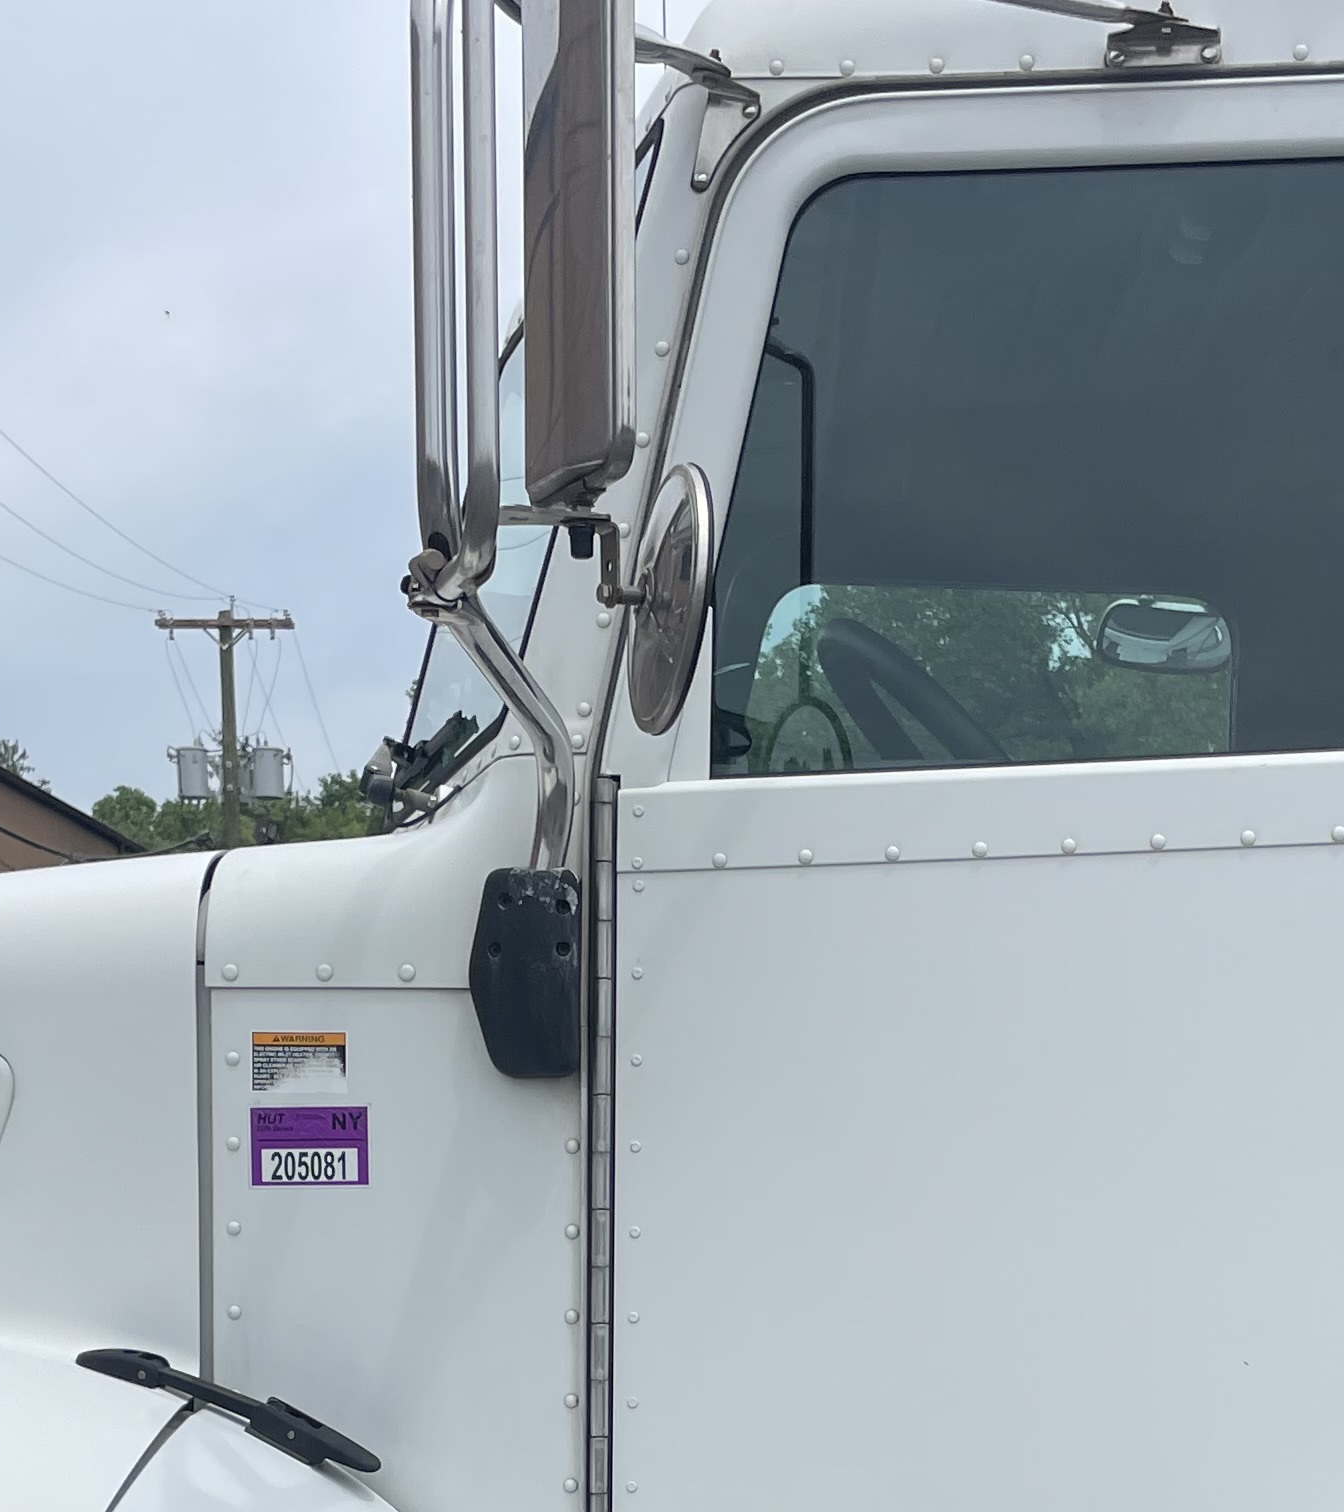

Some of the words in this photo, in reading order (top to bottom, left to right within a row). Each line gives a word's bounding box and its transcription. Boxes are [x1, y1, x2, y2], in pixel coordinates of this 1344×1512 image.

[281, 1034, 326, 1043] WARNING
[257, 1113, 286, 1125] HUT
[332, 1112, 363, 1131] NY
[270, 1151, 347, 1181] 205081
